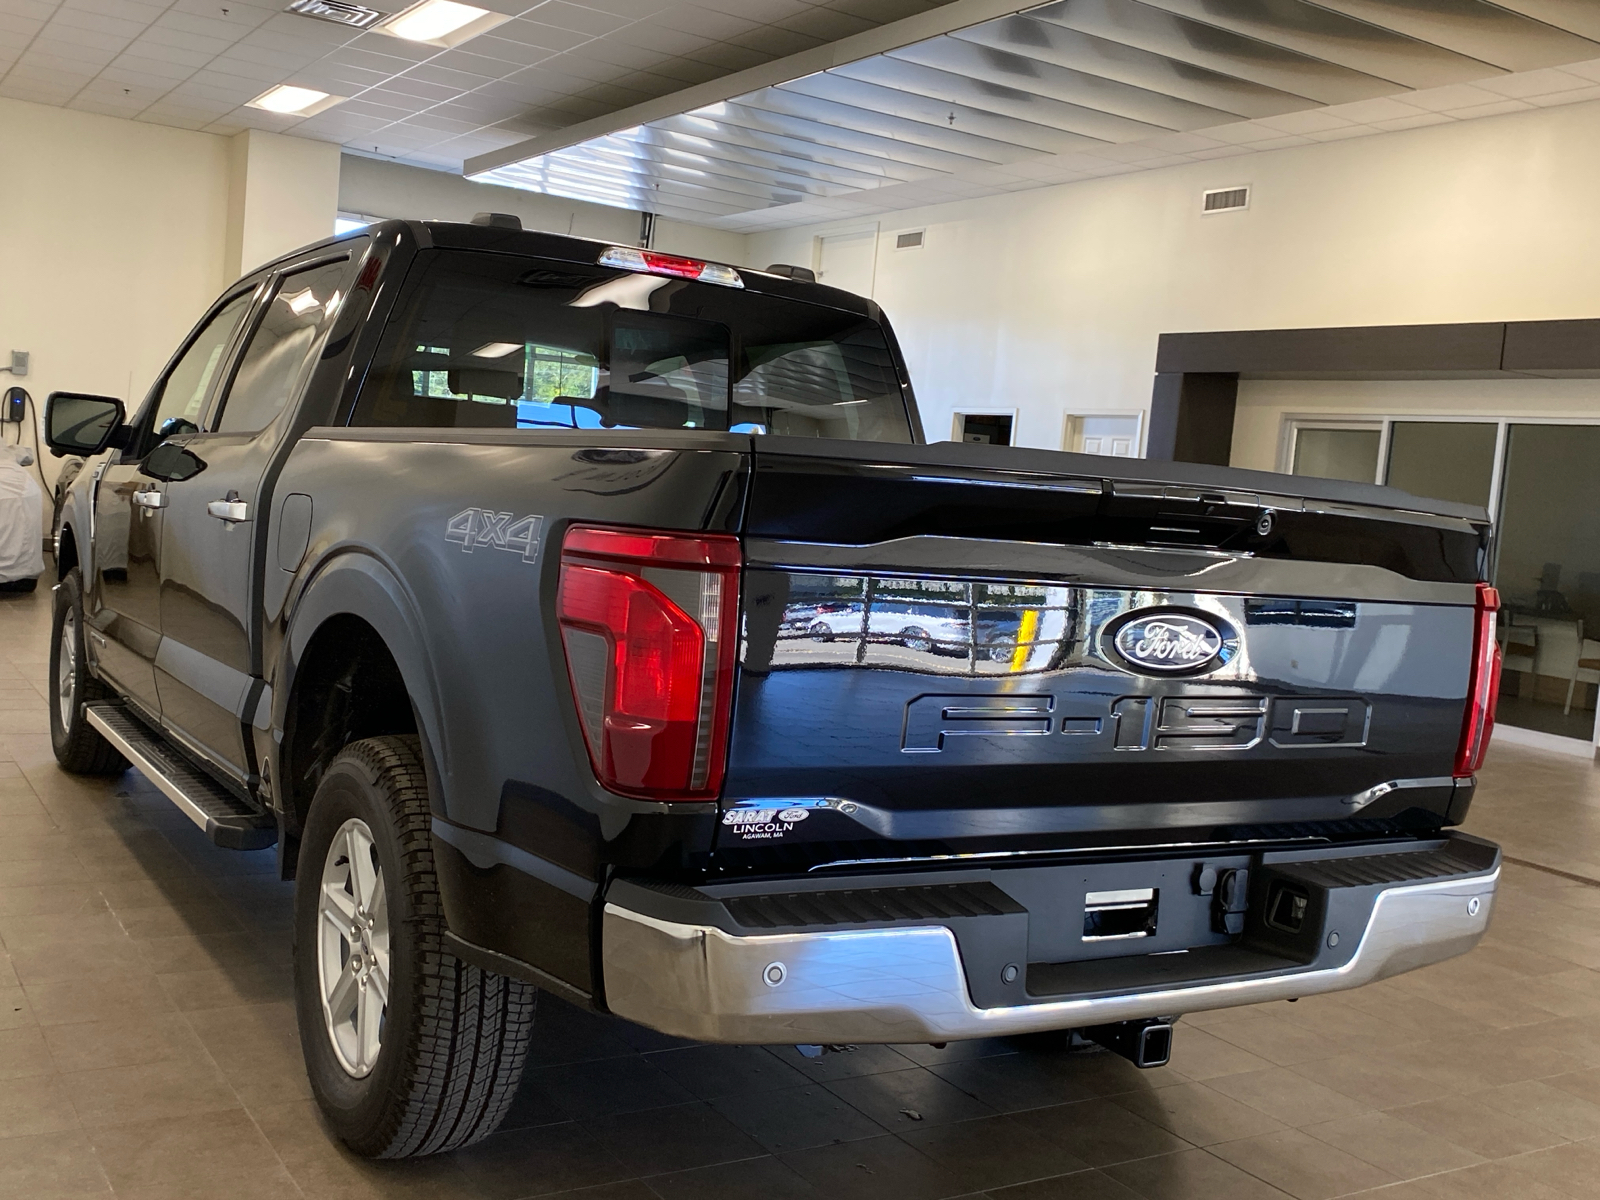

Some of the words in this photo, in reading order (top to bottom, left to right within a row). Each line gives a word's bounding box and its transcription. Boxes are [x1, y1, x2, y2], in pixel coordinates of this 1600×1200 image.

[1135, 621, 1205, 660] Ford
[900, 693, 1373, 753] F-150
[722, 809, 778, 825] SARAT
[733, 822, 794, 834] LINCOLN
